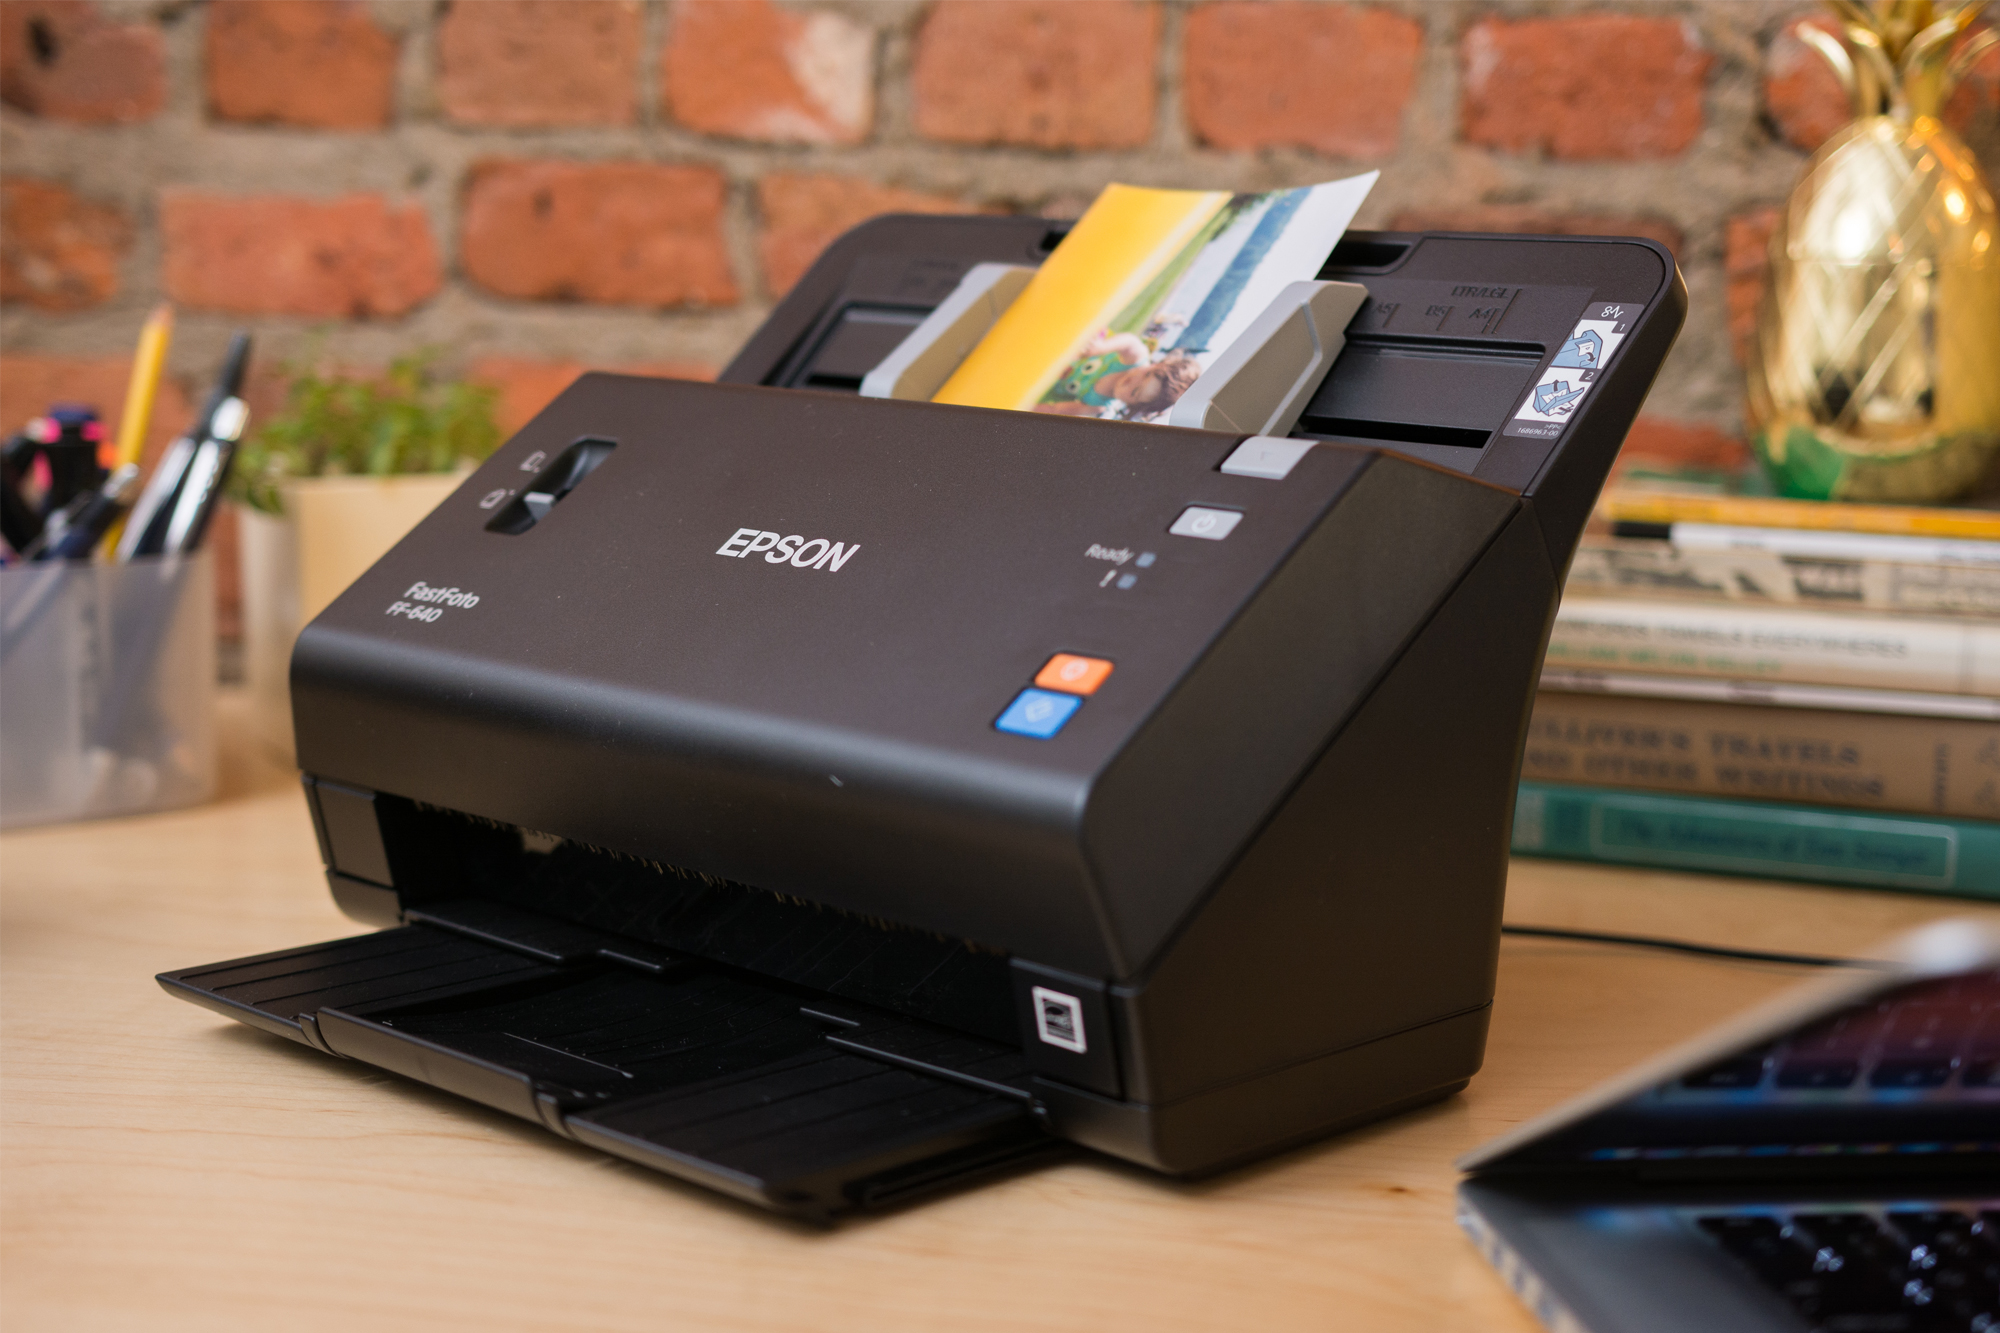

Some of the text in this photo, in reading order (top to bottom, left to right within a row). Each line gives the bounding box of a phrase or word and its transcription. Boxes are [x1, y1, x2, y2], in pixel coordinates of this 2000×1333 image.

[1468, 306, 1492, 320] A4
[1619, 323, 1626, 332] 1
[1585, 371, 1595, 381] 2
[715, 527, 861, 573] EPSON
[1084, 543, 1135, 566] Ready
[403, 581, 480, 609] FastFoto
[385, 600, 443, 623] FF-640
